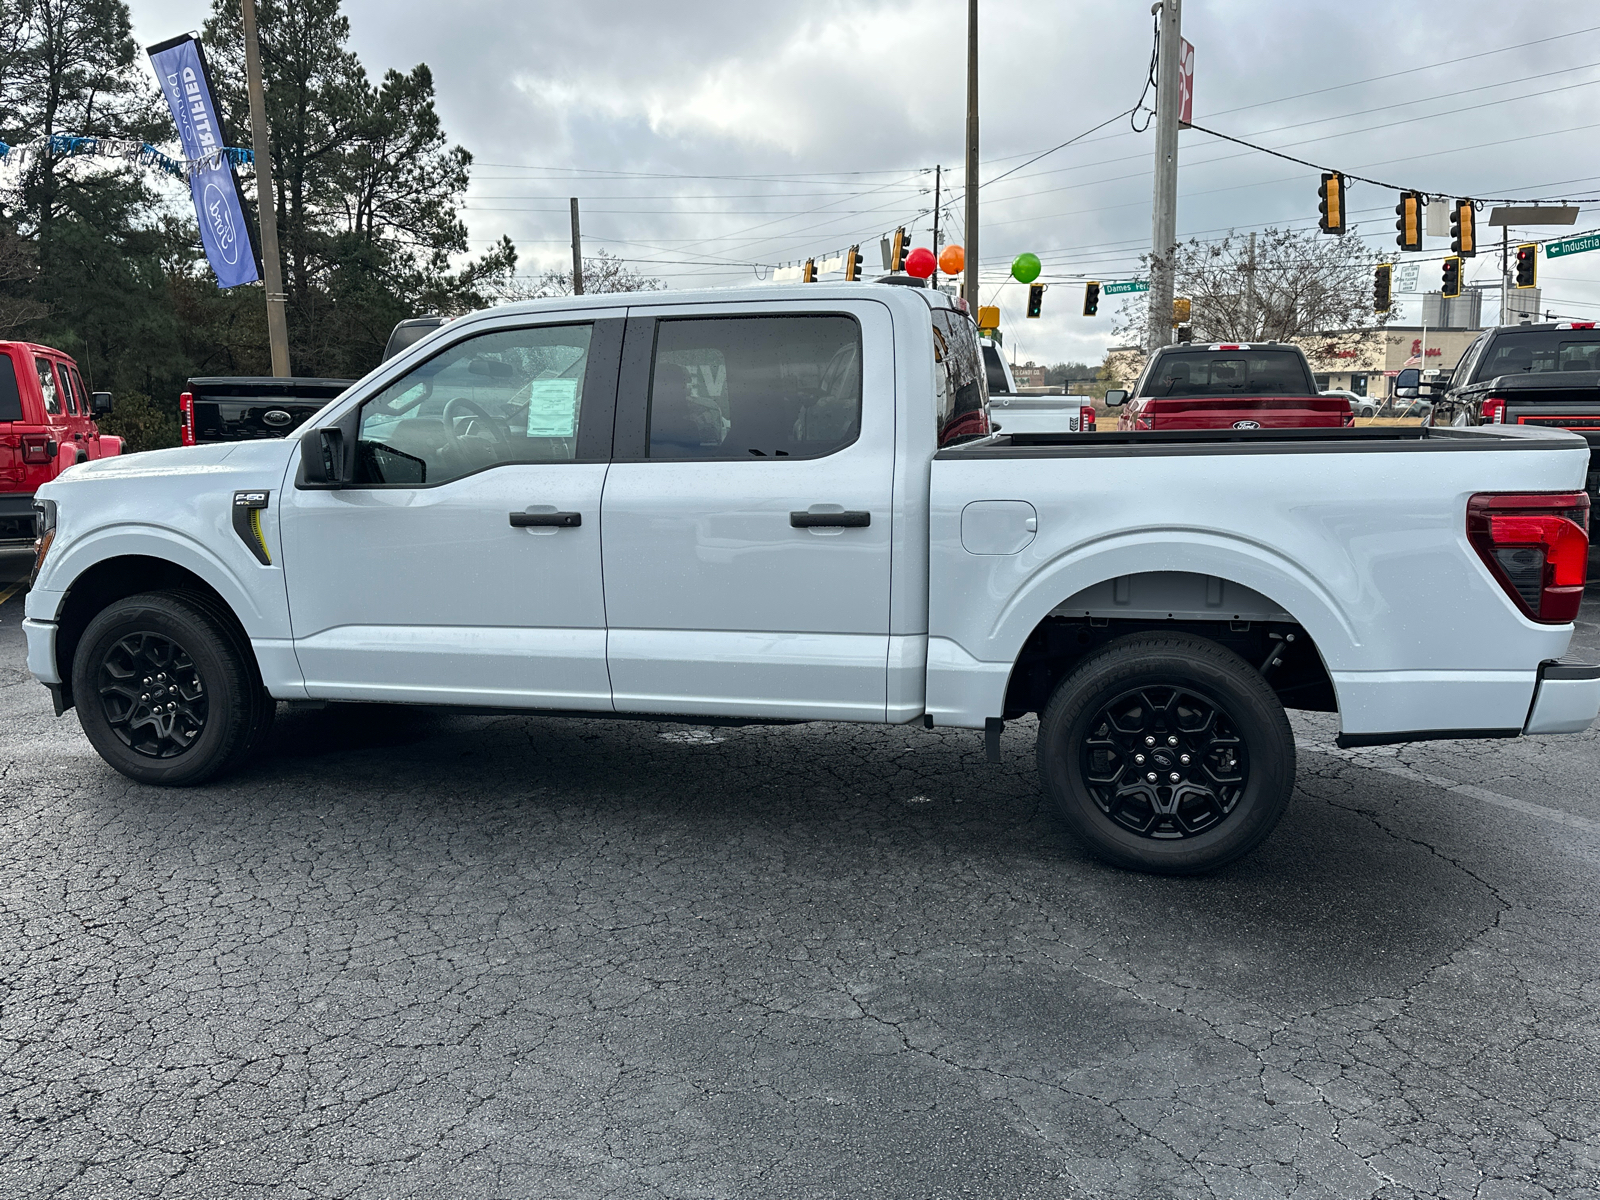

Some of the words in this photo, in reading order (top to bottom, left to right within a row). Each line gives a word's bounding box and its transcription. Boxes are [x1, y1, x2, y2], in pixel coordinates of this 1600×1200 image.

[1562, 237, 1600, 253] Industria
[1106, 284, 1132, 293] Dames
[235, 493, 265, 501] F-150
